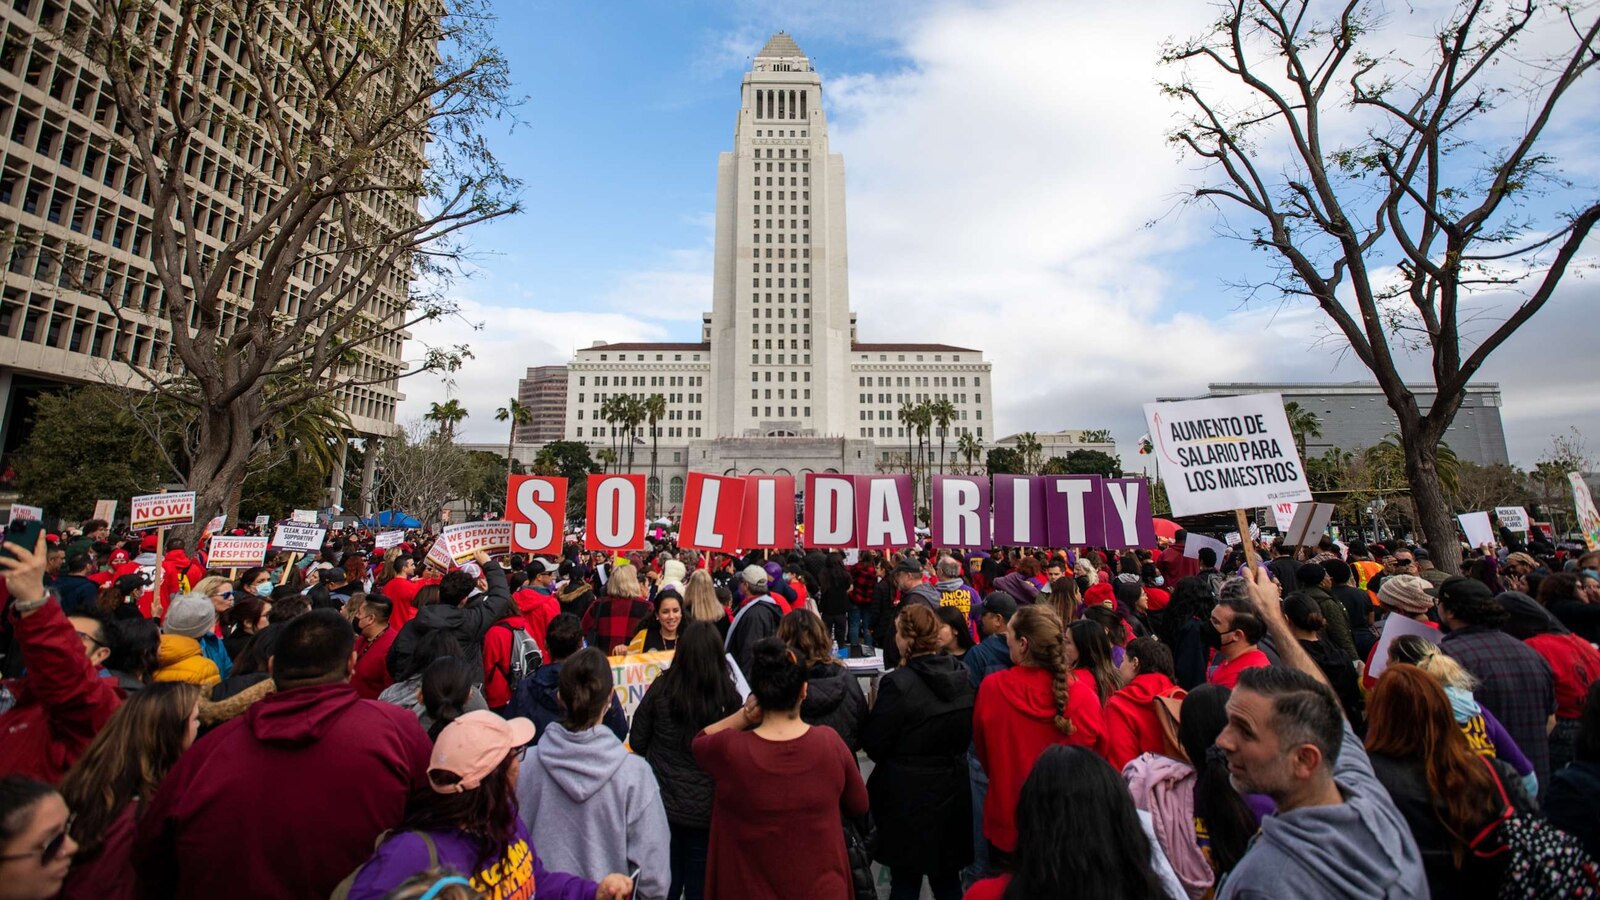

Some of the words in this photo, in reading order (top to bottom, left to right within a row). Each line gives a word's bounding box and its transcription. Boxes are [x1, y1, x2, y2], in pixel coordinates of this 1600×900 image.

[1170, 417, 1242, 442] AUMENTO
[1244, 414, 1267, 435] DE
[1177, 442, 1240, 468] SALARIO
[1239, 439, 1283, 461] PARA
[1184, 469, 1217, 493] LOS
[1217, 461, 1298, 489] MAESTROS
[135, 499, 169, 507] EQUITABLE
[136, 504, 191, 519] NOW!
[447, 532, 464, 542] WE
[465, 528, 510, 538] DEMAND
[214, 541, 265, 549] ¡EXIGIMOS
[450, 536, 510, 554] RESPECT!
